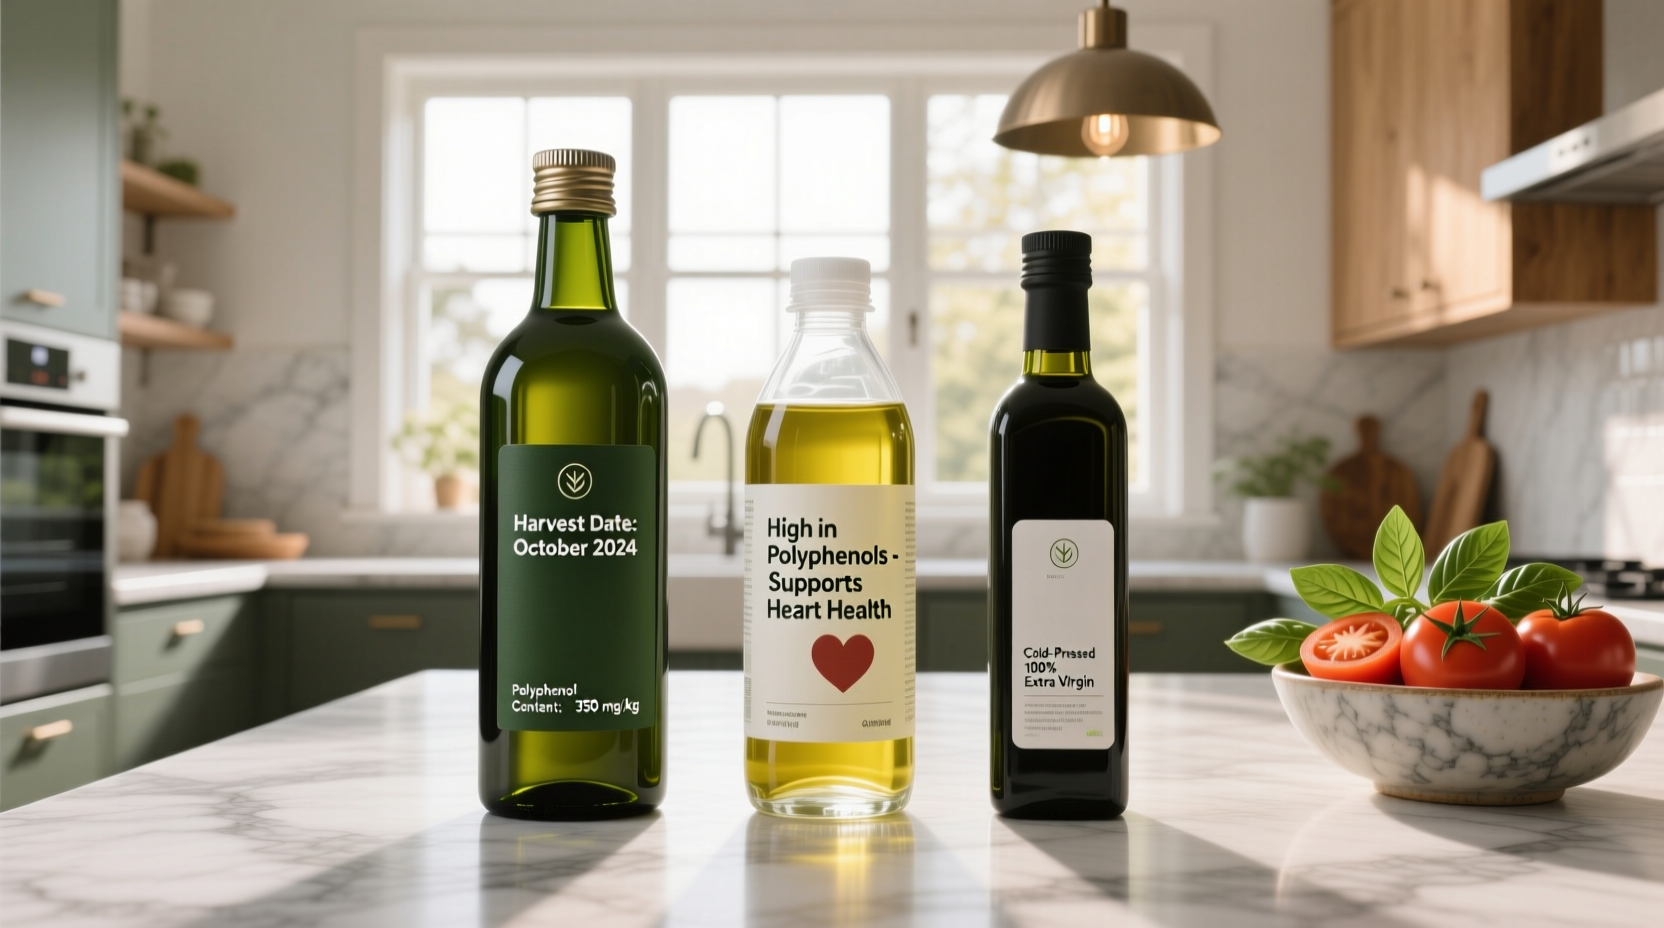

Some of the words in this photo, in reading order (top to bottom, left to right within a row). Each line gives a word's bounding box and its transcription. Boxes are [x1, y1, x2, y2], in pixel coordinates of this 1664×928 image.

[513, 513, 586, 533] Harvest
[589, 513, 638, 533] Date:
[767, 516, 813, 543] High
[818, 517, 838, 539] in
[512, 537, 589, 557] October
[592, 538, 639, 557] 2024
[767, 544, 889, 570] Polyphenols
[768, 571, 863, 597] Supports
[767, 598, 822, 620] Heart
[827, 598, 892, 620] Health
[1024, 661, 1057, 674] 100%
[511, 683, 578, 700] Polyphenol
[1024, 675, 1056, 688] Extra
[1057, 674, 1095, 691] Virgin
[574, 698, 599, 713] 350
[602, 697, 640, 716] mg/kg
